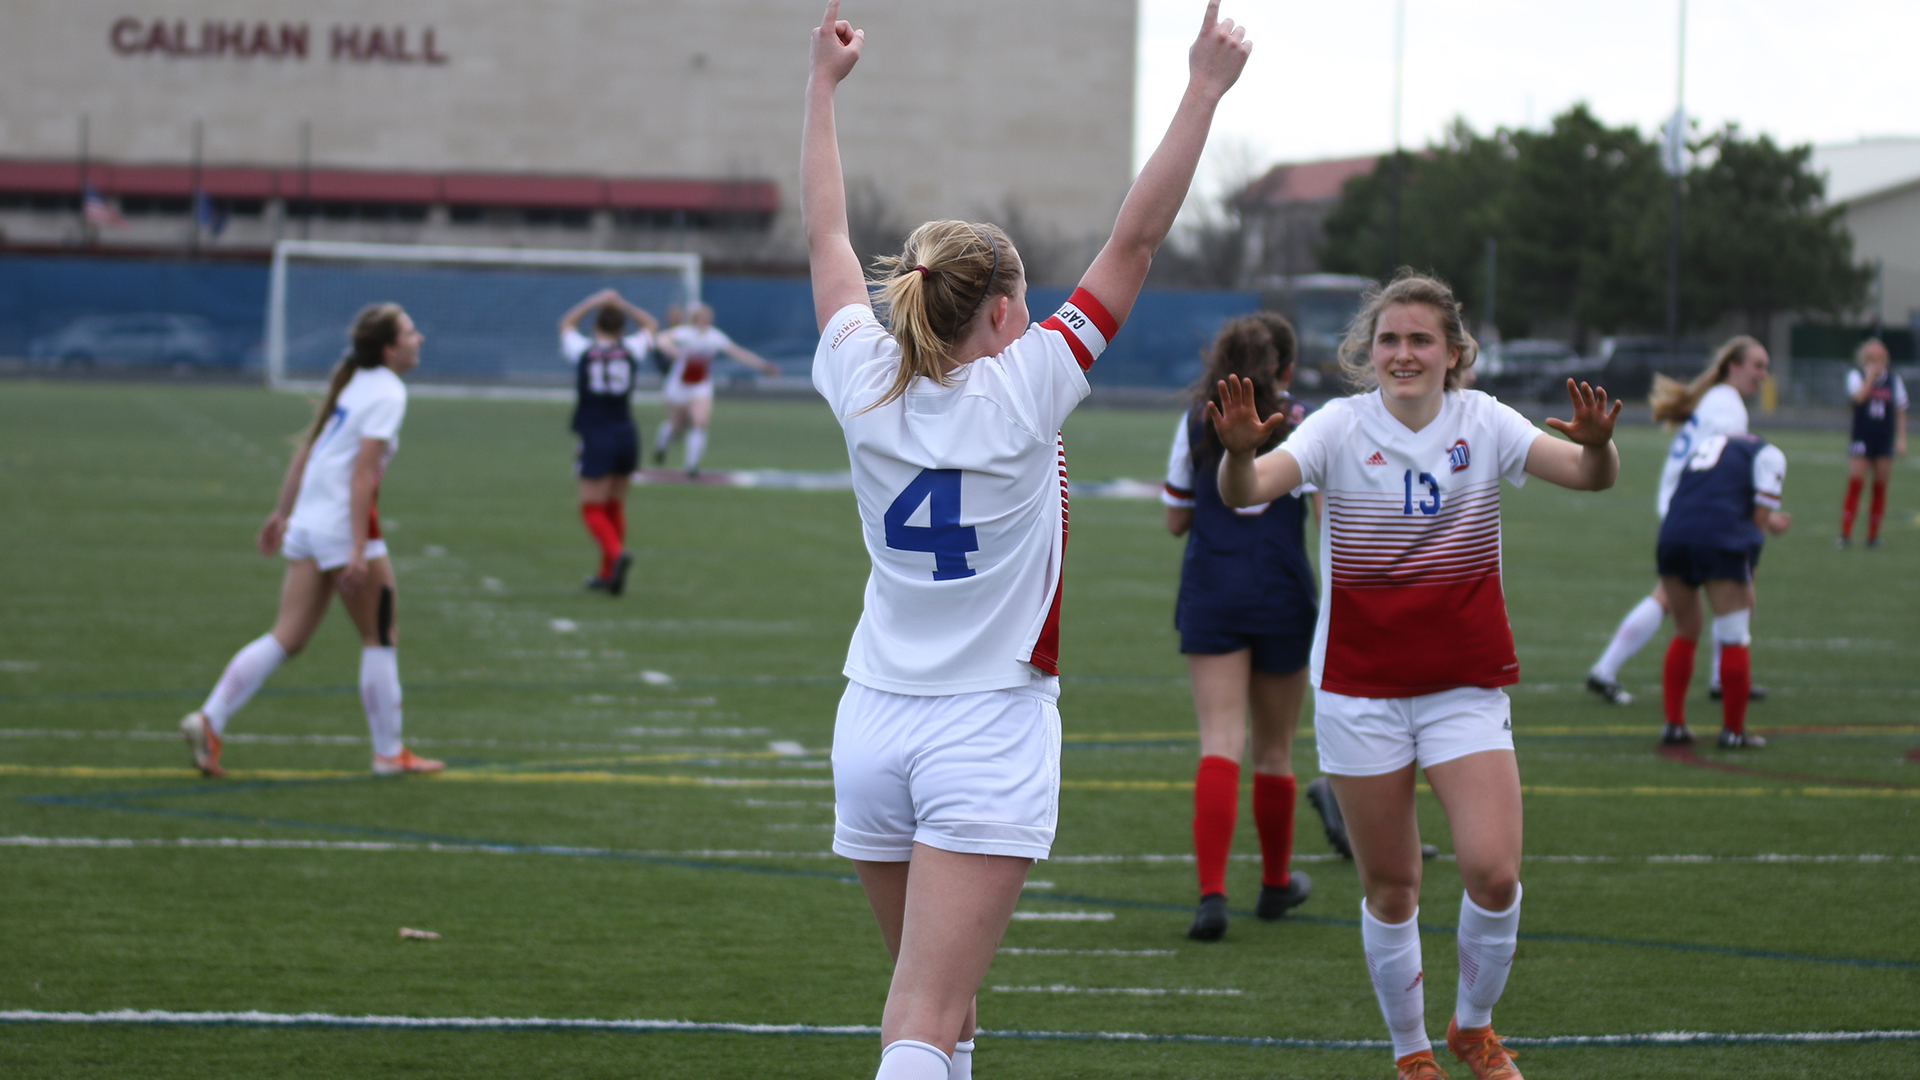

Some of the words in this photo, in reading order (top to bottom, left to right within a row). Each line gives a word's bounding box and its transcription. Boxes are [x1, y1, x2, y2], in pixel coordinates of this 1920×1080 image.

[110, 17, 309, 59] CALIHAN
[330, 24, 450, 65] HALL
[829, 318, 862, 350] HORIZON
[1403, 468, 1442, 515] 13
[883, 467, 979, 581] 4
